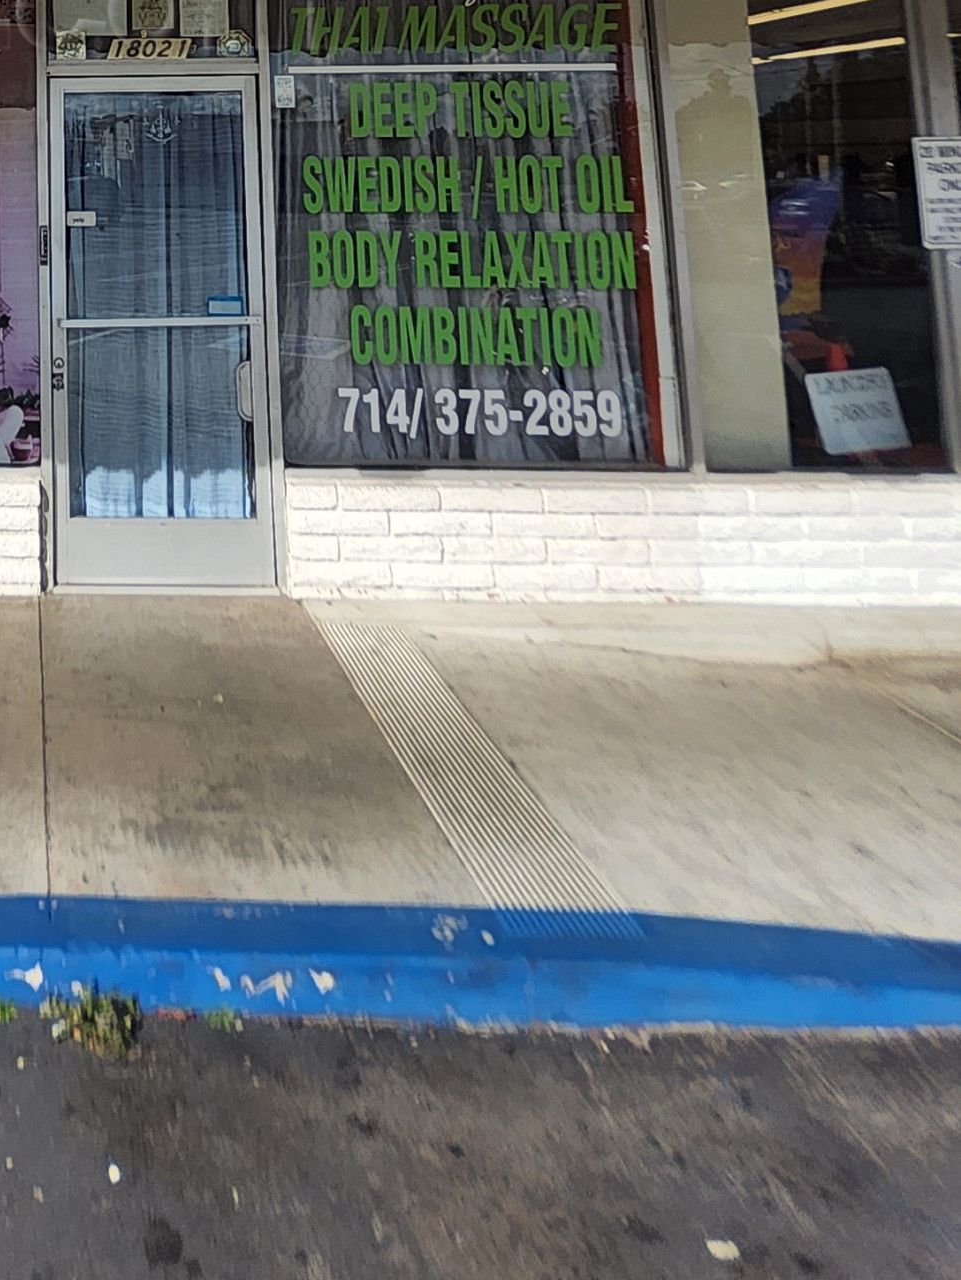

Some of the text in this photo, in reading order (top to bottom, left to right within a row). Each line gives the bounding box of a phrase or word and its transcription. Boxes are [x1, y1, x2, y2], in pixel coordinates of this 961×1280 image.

[114, 39, 188, 58] 18021
[291, 3, 623, 55] THAI MASSAGE
[349, 81, 437, 138] DEEP
[450, 80, 575, 138] TISSUE
[302, 154, 635, 220] SWEDISH / HOT OIL
[308, 230, 638, 290] BODY RELAXATION
[350, 304, 602, 368] COMBINATION
[338, 387, 623, 440] 714/ 375-2859
